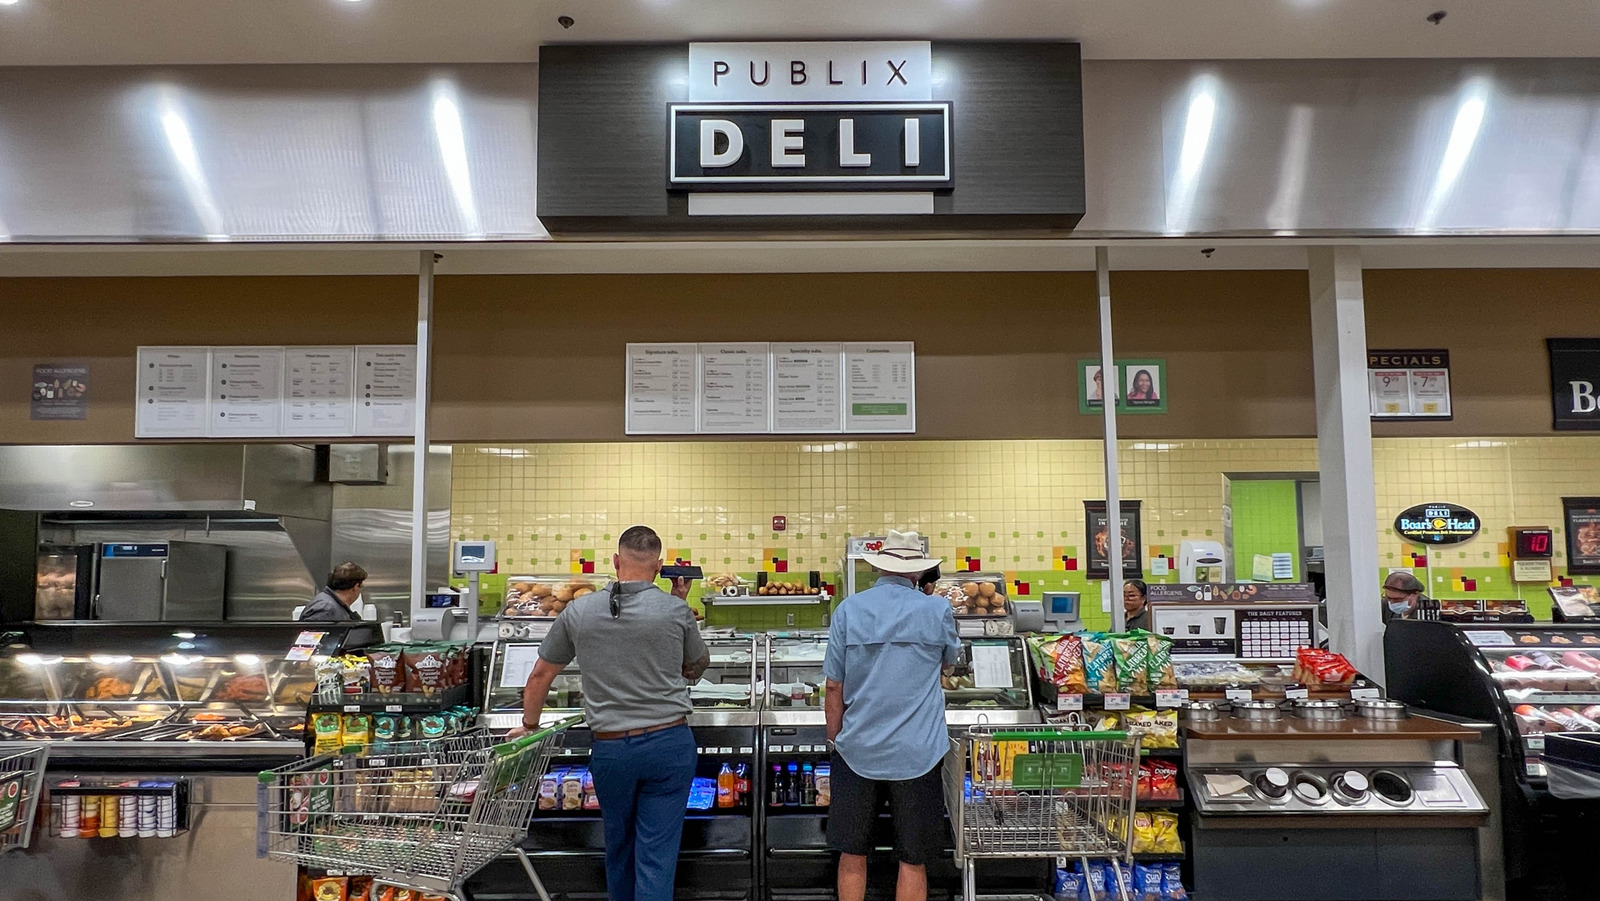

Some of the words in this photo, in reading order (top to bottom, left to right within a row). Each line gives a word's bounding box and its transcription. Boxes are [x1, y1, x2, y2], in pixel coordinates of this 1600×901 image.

[713, 60, 908, 86] PUBLIX
[700, 118, 920, 168] DELI
[1369, 356, 1441, 365] PECIALS
[1401, 518, 1432, 530] Boar's
[1446, 517, 1475, 530] Head
[1531, 534, 1549, 552] 10
[1154, 719, 1173, 727] AKED
